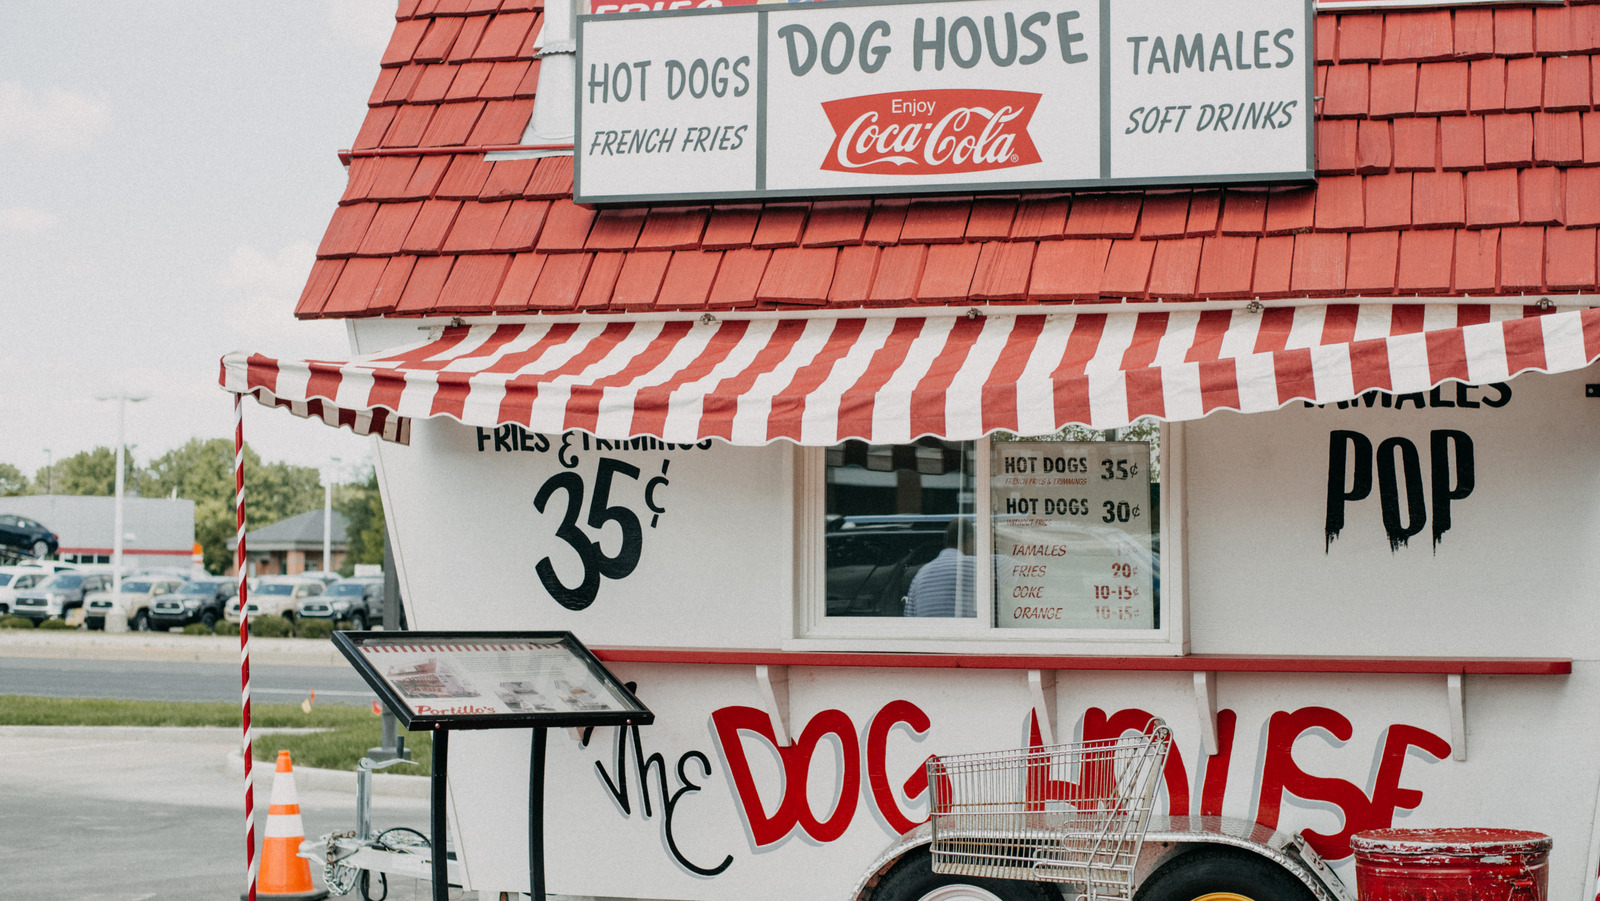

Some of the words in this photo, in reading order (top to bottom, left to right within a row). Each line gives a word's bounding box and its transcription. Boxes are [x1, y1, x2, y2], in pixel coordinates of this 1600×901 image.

[777, 19, 892, 77] DOG
[913, 10, 1089, 72] HOUSE
[1126, 28, 1294, 75] TAMALES
[588, 60, 652, 104] HOT
[664, 55, 750, 100] DOGS
[891, 98, 936, 116] Enjoy
[1125, 105, 1192, 135] SOFT
[1196, 100, 1298, 133] DRINKS
[588, 128, 676, 157] FRENCH
[681, 124, 749, 153] FRIES
[1004, 456, 1037, 474] HOT
[1043, 456, 1088, 474] DOGS
[1101, 458, 1139, 480] 35¢
[1325, 429, 1475, 557] POP
[1006, 498, 1039, 515] HOT
[1044, 498, 1089, 516] DOGS
[1102, 500, 1140, 523] 30¢
[1012, 544, 1067, 557] TAMALES
[1012, 565, 1047, 577] FRIES
[1111, 562, 1138, 578] 20¢
[1012, 585, 1045, 598] COKE
[1013, 606, 1063, 620] ORANGE
[415, 705, 496, 716] Portillo's
[711, 700, 952, 847] DOG
